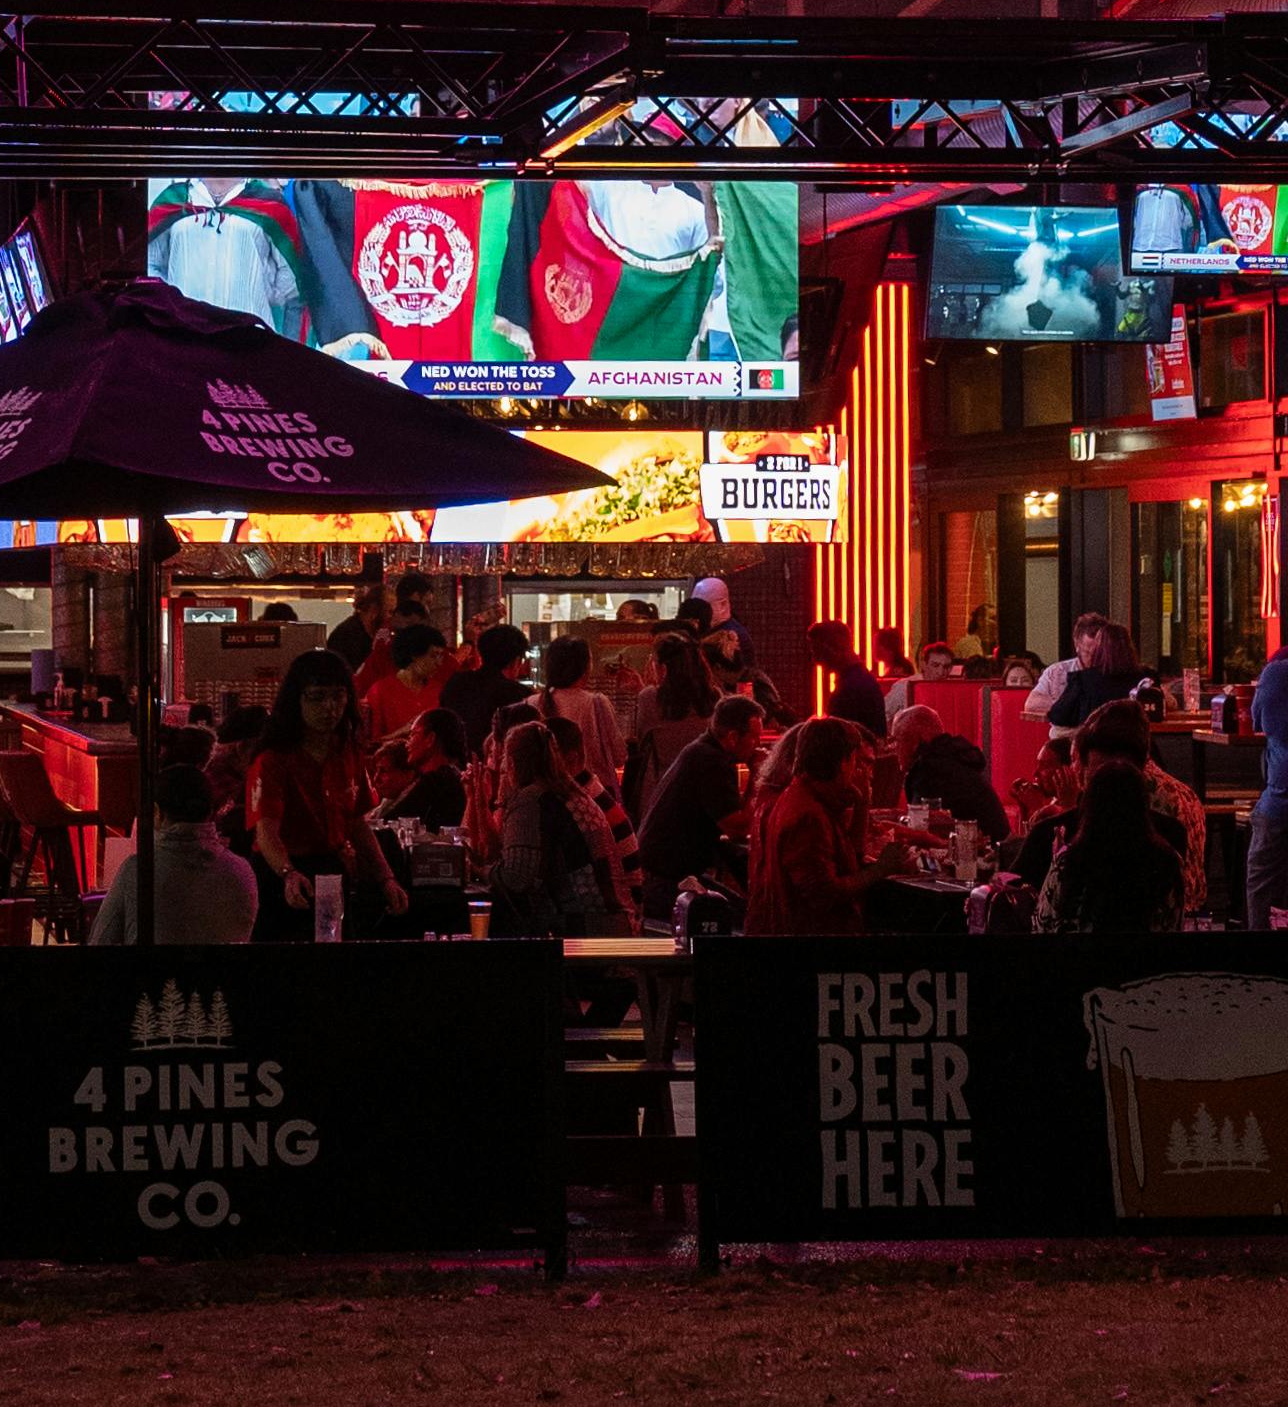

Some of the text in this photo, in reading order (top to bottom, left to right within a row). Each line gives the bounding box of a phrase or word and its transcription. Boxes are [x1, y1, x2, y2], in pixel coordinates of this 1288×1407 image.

[421, 366, 723, 386] NED WON THE TOSS AFGHANISTAN
[433, 381, 543, 392] AND ELECTED TO BAT
[202, 409, 317, 433] 4 PINES
[200, 432, 354, 457] BREWING
[268, 461, 331, 482] CO.
[721, 478, 831, 510] BURGERS
[816, 969, 969, 1039] FRESH
[73, 1060, 285, 1112] 4 PINES
[818, 1042, 971, 1123] BEER
[48, 1118, 320, 1174] BREWING
[821, 1128, 976, 1209] HERE
[137, 1180, 242, 1231] CO.
